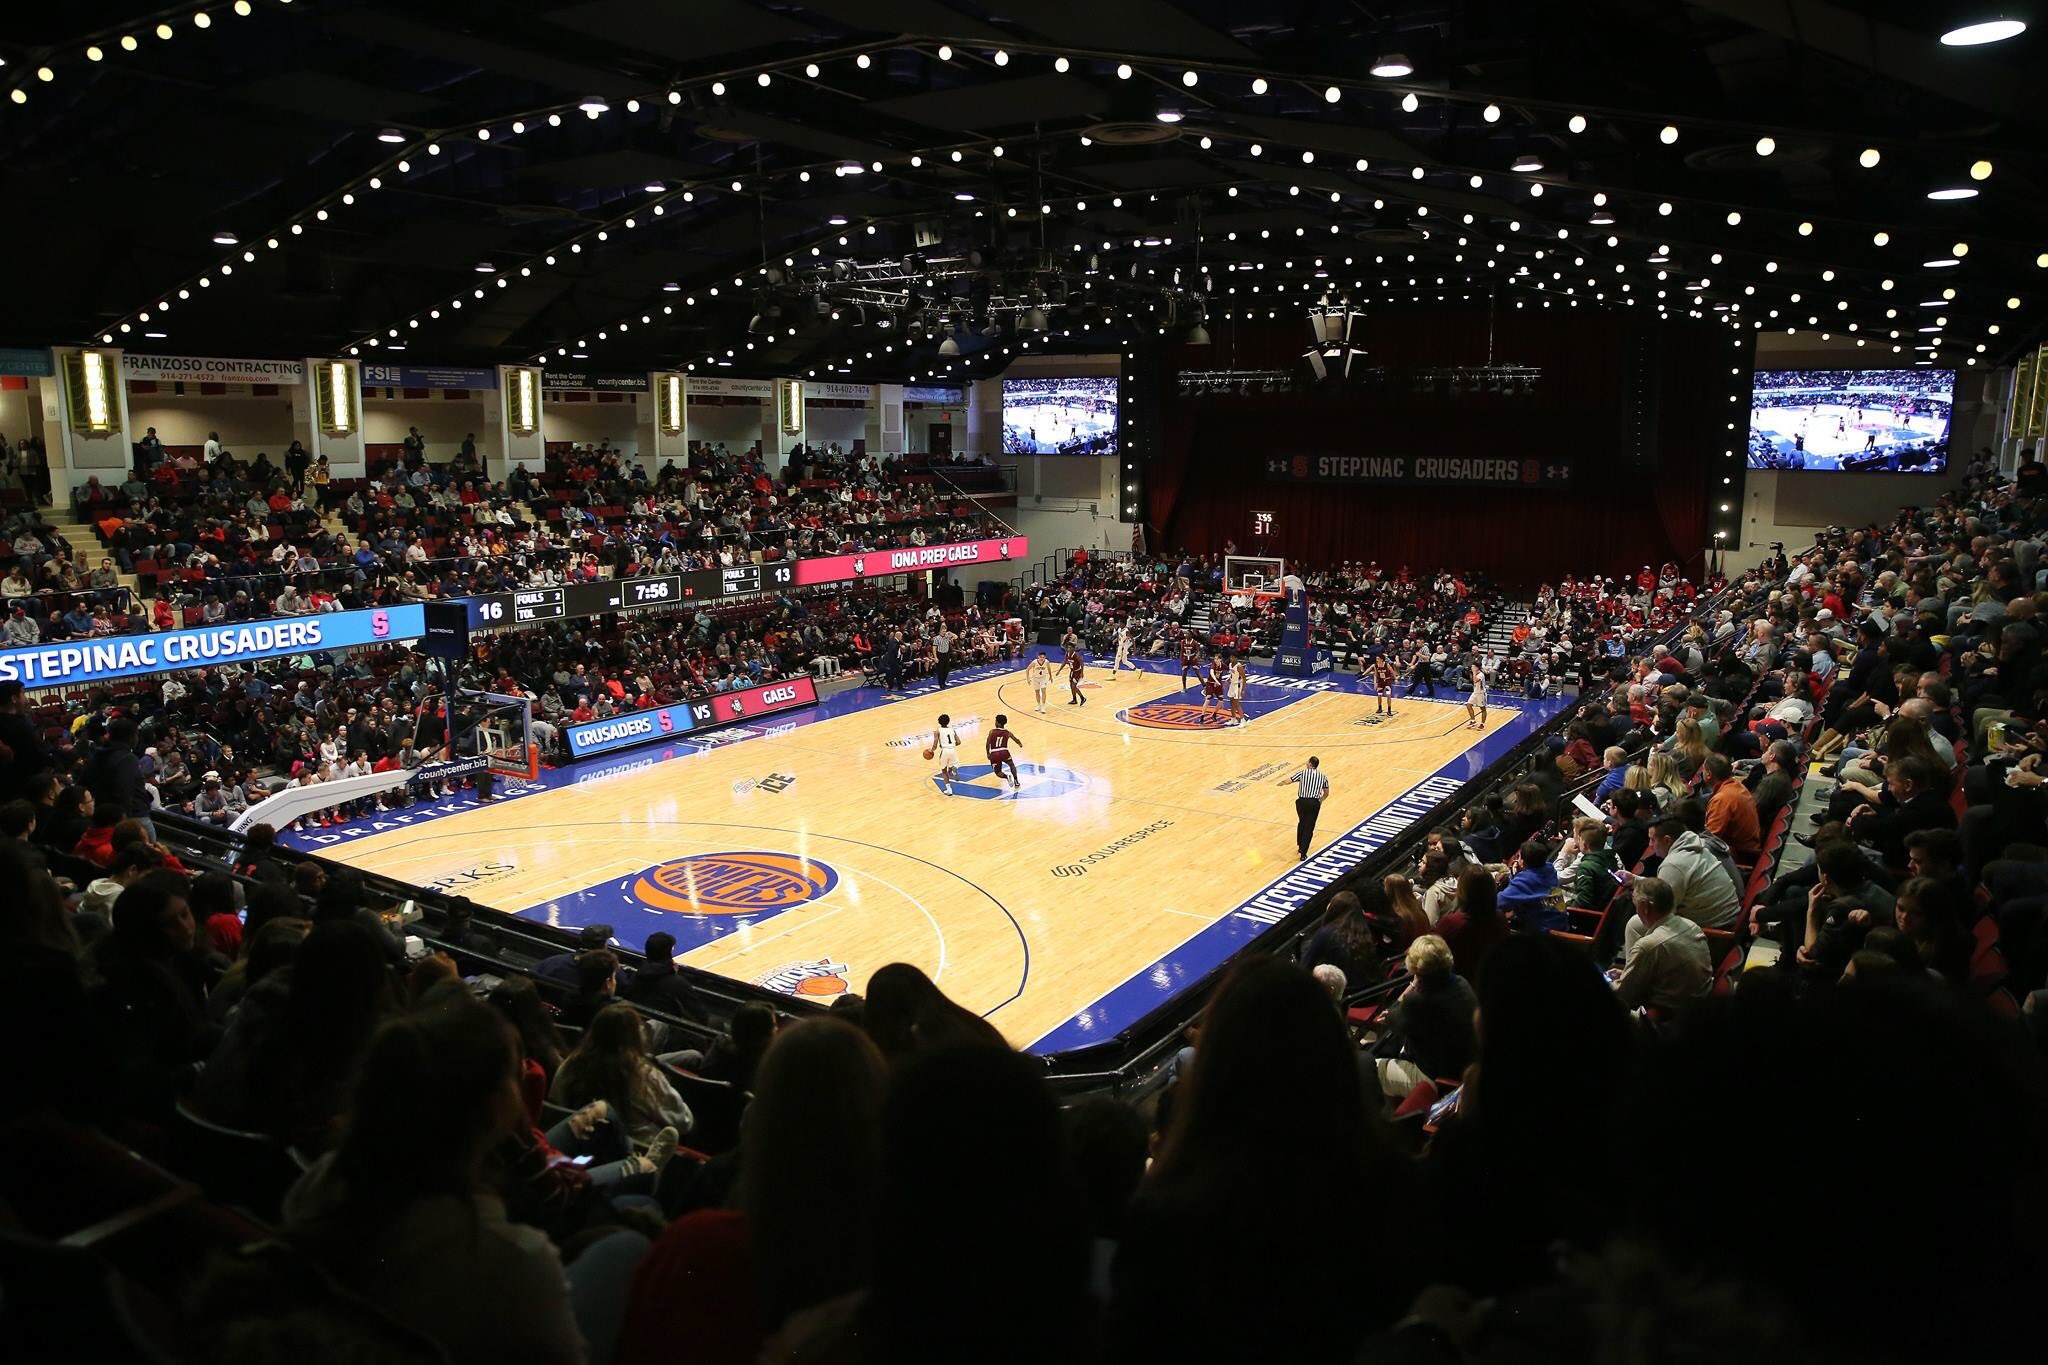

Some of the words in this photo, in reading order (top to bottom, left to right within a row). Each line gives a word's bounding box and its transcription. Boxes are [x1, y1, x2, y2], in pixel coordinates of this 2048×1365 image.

[123, 356, 203, 371] FRANZOSO
[206, 361, 302, 374] CONTRACTING
[364, 366, 391, 380] FSI
[222, 375, 270, 383] franzoso.com
[597, 379, 646, 387] countycenter.biz
[731, 384, 771, 392] countycenter.biz
[1318, 456, 1404, 478] STEPINAC
[1415, 458, 1518, 481] CRUSADERS
[1254, 521, 1270, 535] 31
[891, 551, 918, 569] IONA
[920, 548, 947, 565] PREP
[948, 544, 978, 562] GAELS
[724, 569, 745, 580] FOULS
[775, 568, 791, 582] 13
[635, 582, 669, 600] 7:56
[725, 583, 739, 592] TOL
[517, 593, 544, 605] FOULS
[479, 602, 503, 620] 16
[518, 609, 536, 619] TOL
[0, 638, 158, 682] STEPINAC
[164, 620, 323, 662] CRUSADERS
[1222, 673, 1339, 691] NICKS
[762, 685, 796, 705] GAELS
[693, 701, 711, 720] VS
[659, 709, 673, 732] S
[576, 717, 652, 748] CRUSADERS
[947, 734, 952, 744] 1
[995, 736, 1004, 748] 11
[418, 759, 488, 780] countycenter.biz
[1079, 819, 1174, 865] SQUARESPACE
[1234, 840, 1378, 925] WESTCHESTER
[1352, 803, 1421, 844] COUNTY
[1401, 776, 1467, 814] CENTER
